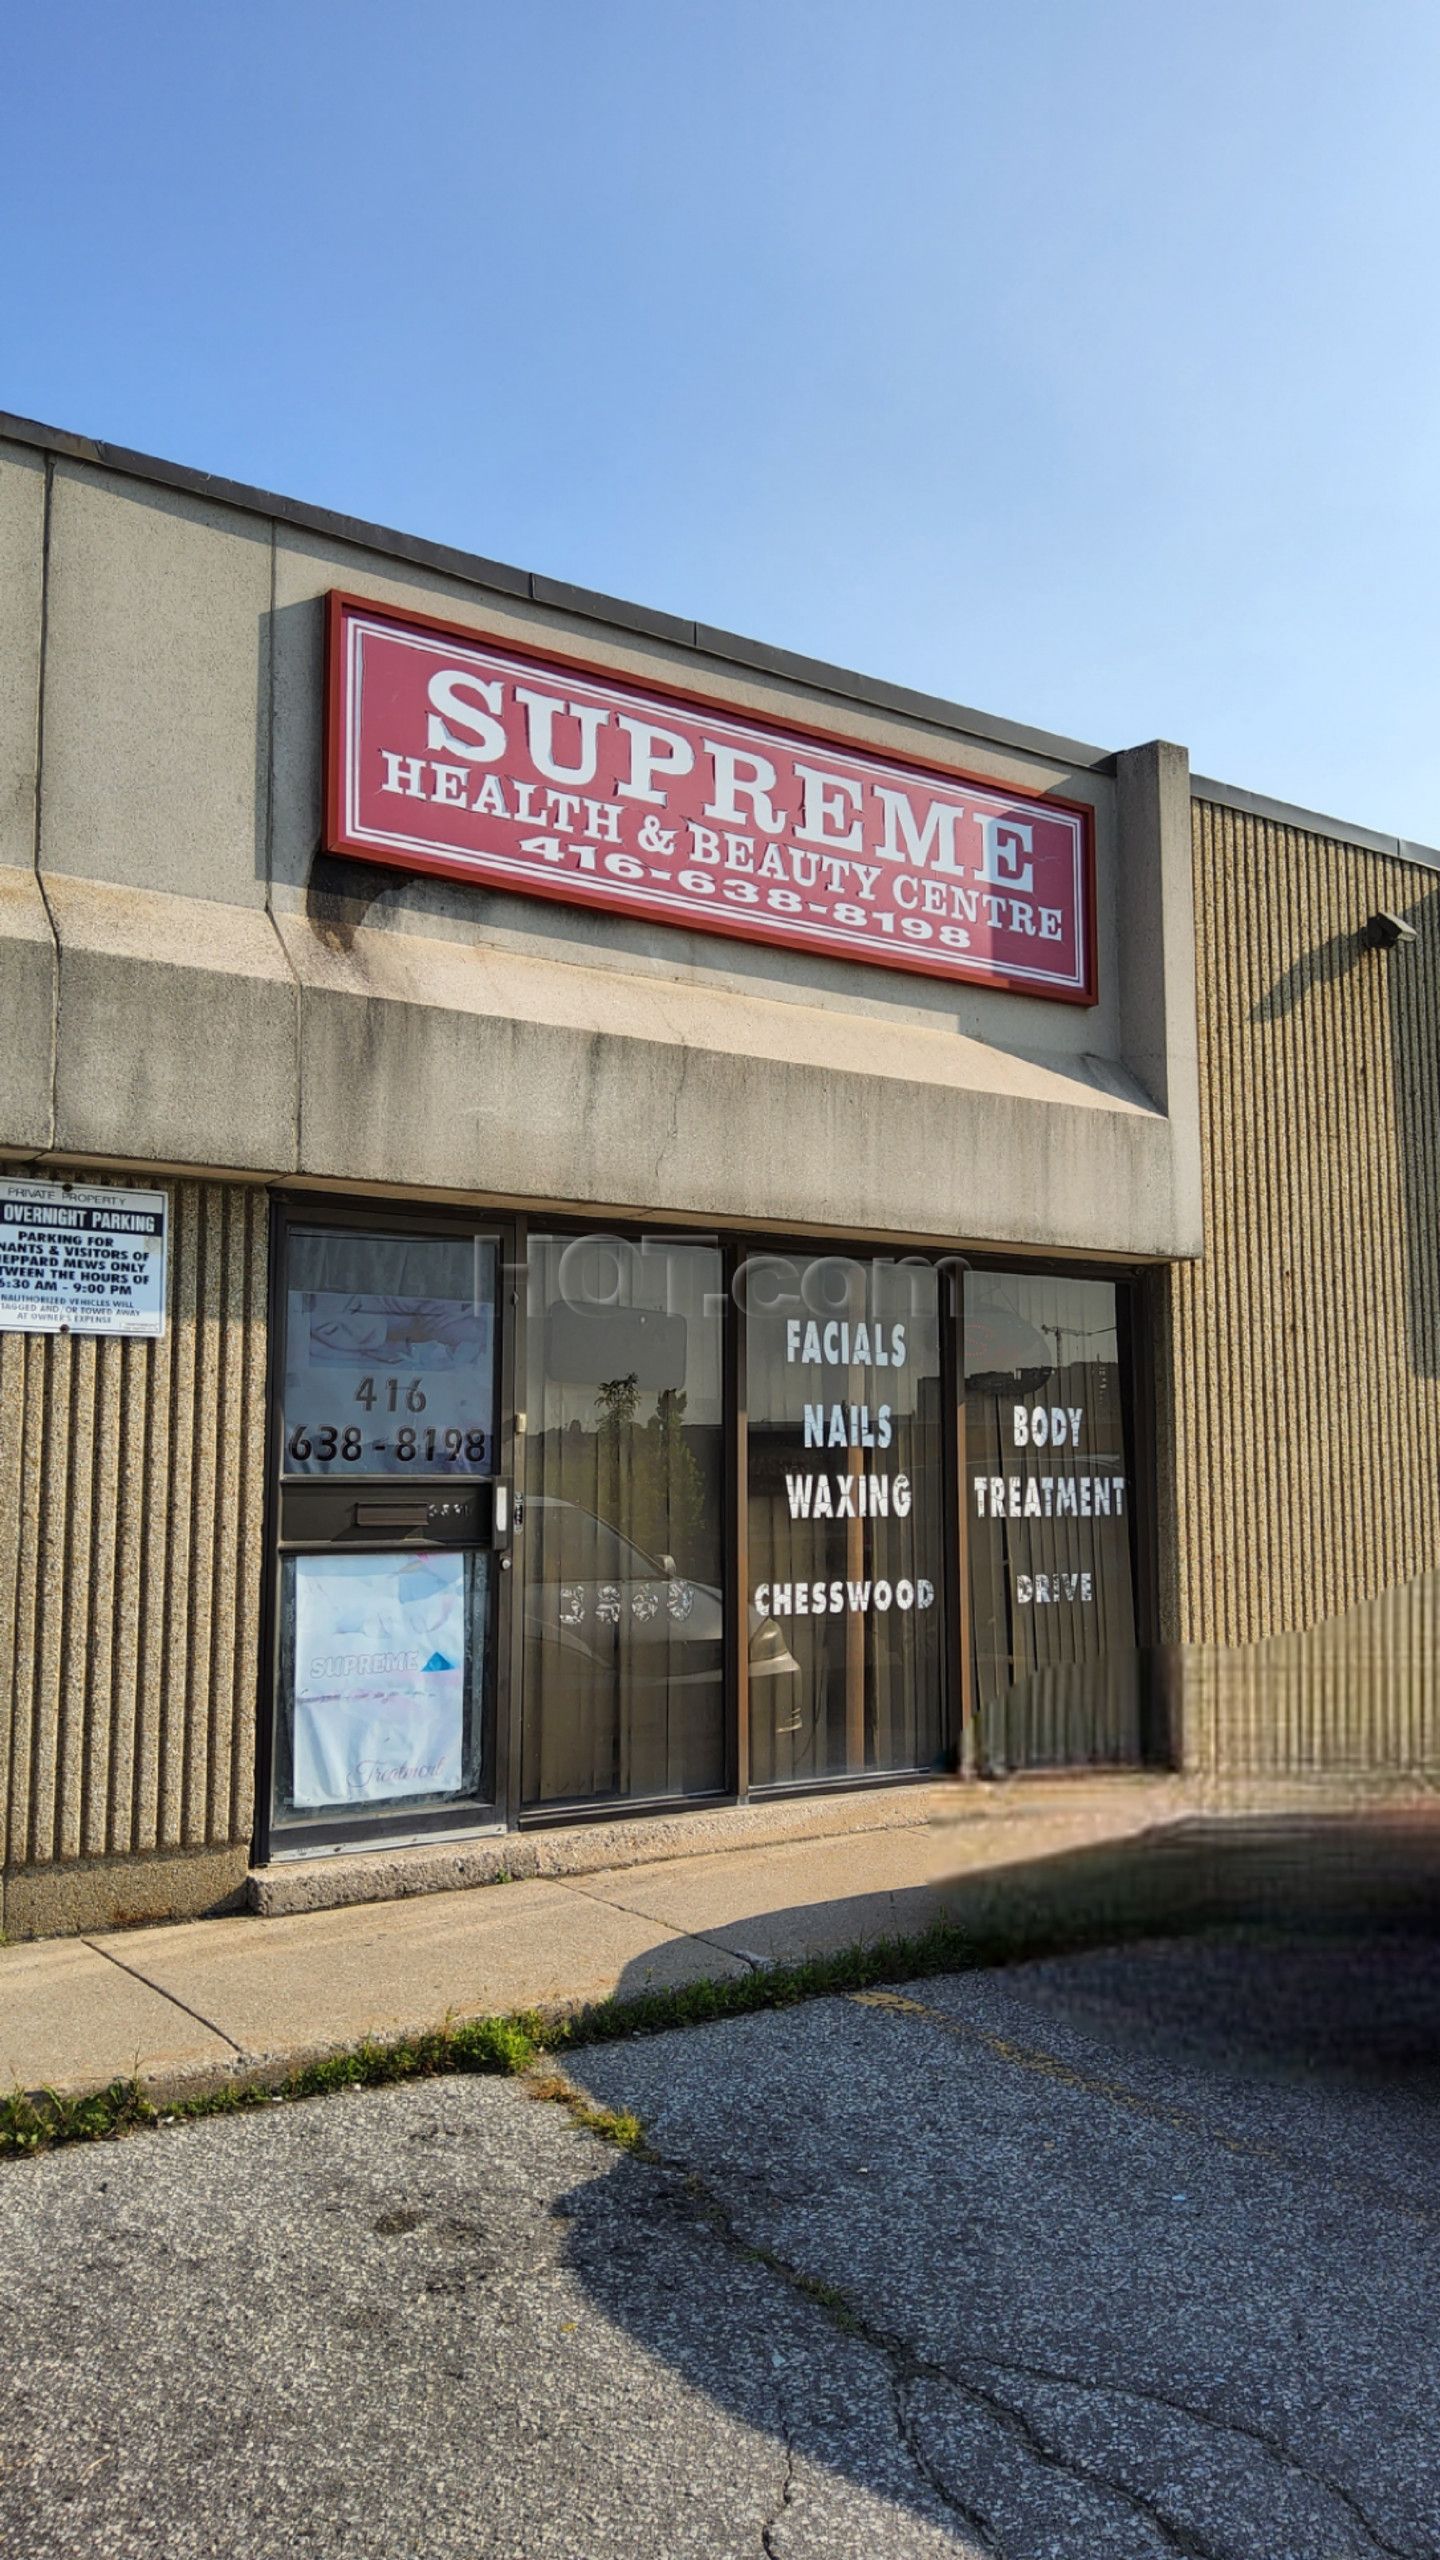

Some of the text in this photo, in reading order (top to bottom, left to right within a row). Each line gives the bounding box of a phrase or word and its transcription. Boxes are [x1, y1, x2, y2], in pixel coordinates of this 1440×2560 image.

[427, 669, 1034, 894] SUPREME
[380, 748, 1063, 942] HEALTH & BEAUTY CENTRE
[519, 836, 971, 949] 416-638-8198
[8, 1186, 127, 1205] PRIVATE PROPERTY
[3, 1203, 155, 1233] OVERNIGHT PARKING
[18, 1230, 114, 1248] PARKING FOR
[49, 1244, 59, 1256] &
[64, 1246, 128, 1261] VISITORS
[132, 1251, 150, 1262] OF
[0, 1253, 146, 1274] EPPARD MEWS ONLY
[51, 1269, 76, 1281] THE
[80, 1271, 128, 1284] HOURS
[132, 1274, 150, 1285] OF
[34, 1280, 58, 1292] AM
[73, 1283, 105, 1294] 9:00
[110, 1284, 132, 1296] PM
[69, 1297, 110, 1307] VEHICLES
[113, 1300, 134, 1308] WILL
[81, 1307, 113, 1315] TOWED
[787, 1319, 907, 1368] FACIALS
[355, 1376, 427, 1412] 416
[803, 1404, 892, 1448] NAILS
[1013, 1405, 1083, 1447] BODY
[785, 1473, 912, 1519] WAXING
[974, 1476, 1126, 1517] TREATMENT
[755, 1579, 935, 1617] CHESSWOOD
[1017, 1572, 1092, 1604] DRIVE
[310, 1650, 419, 1679] SUPREME
